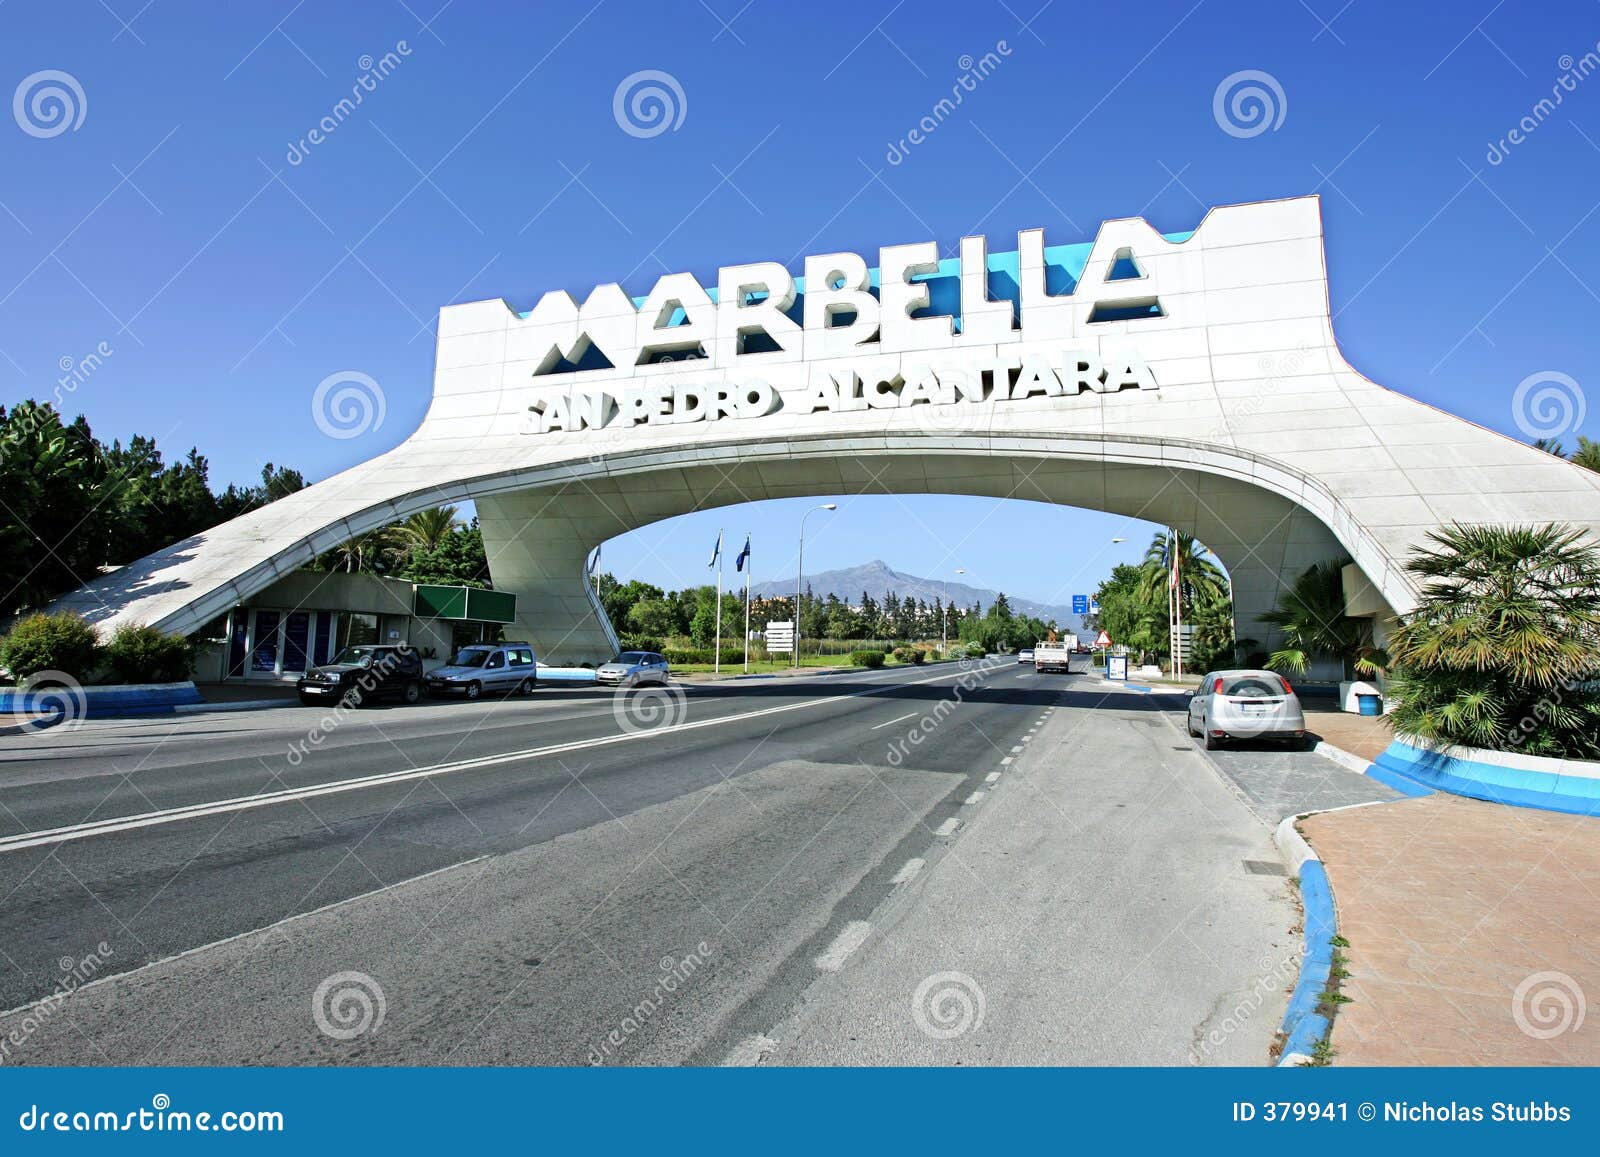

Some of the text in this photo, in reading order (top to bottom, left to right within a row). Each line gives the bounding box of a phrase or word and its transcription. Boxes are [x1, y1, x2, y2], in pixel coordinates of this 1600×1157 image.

[514, 217, 1185, 379] MARBELLA
[517, 350, 1160, 434] SAN PEDRO ALCANTARA
